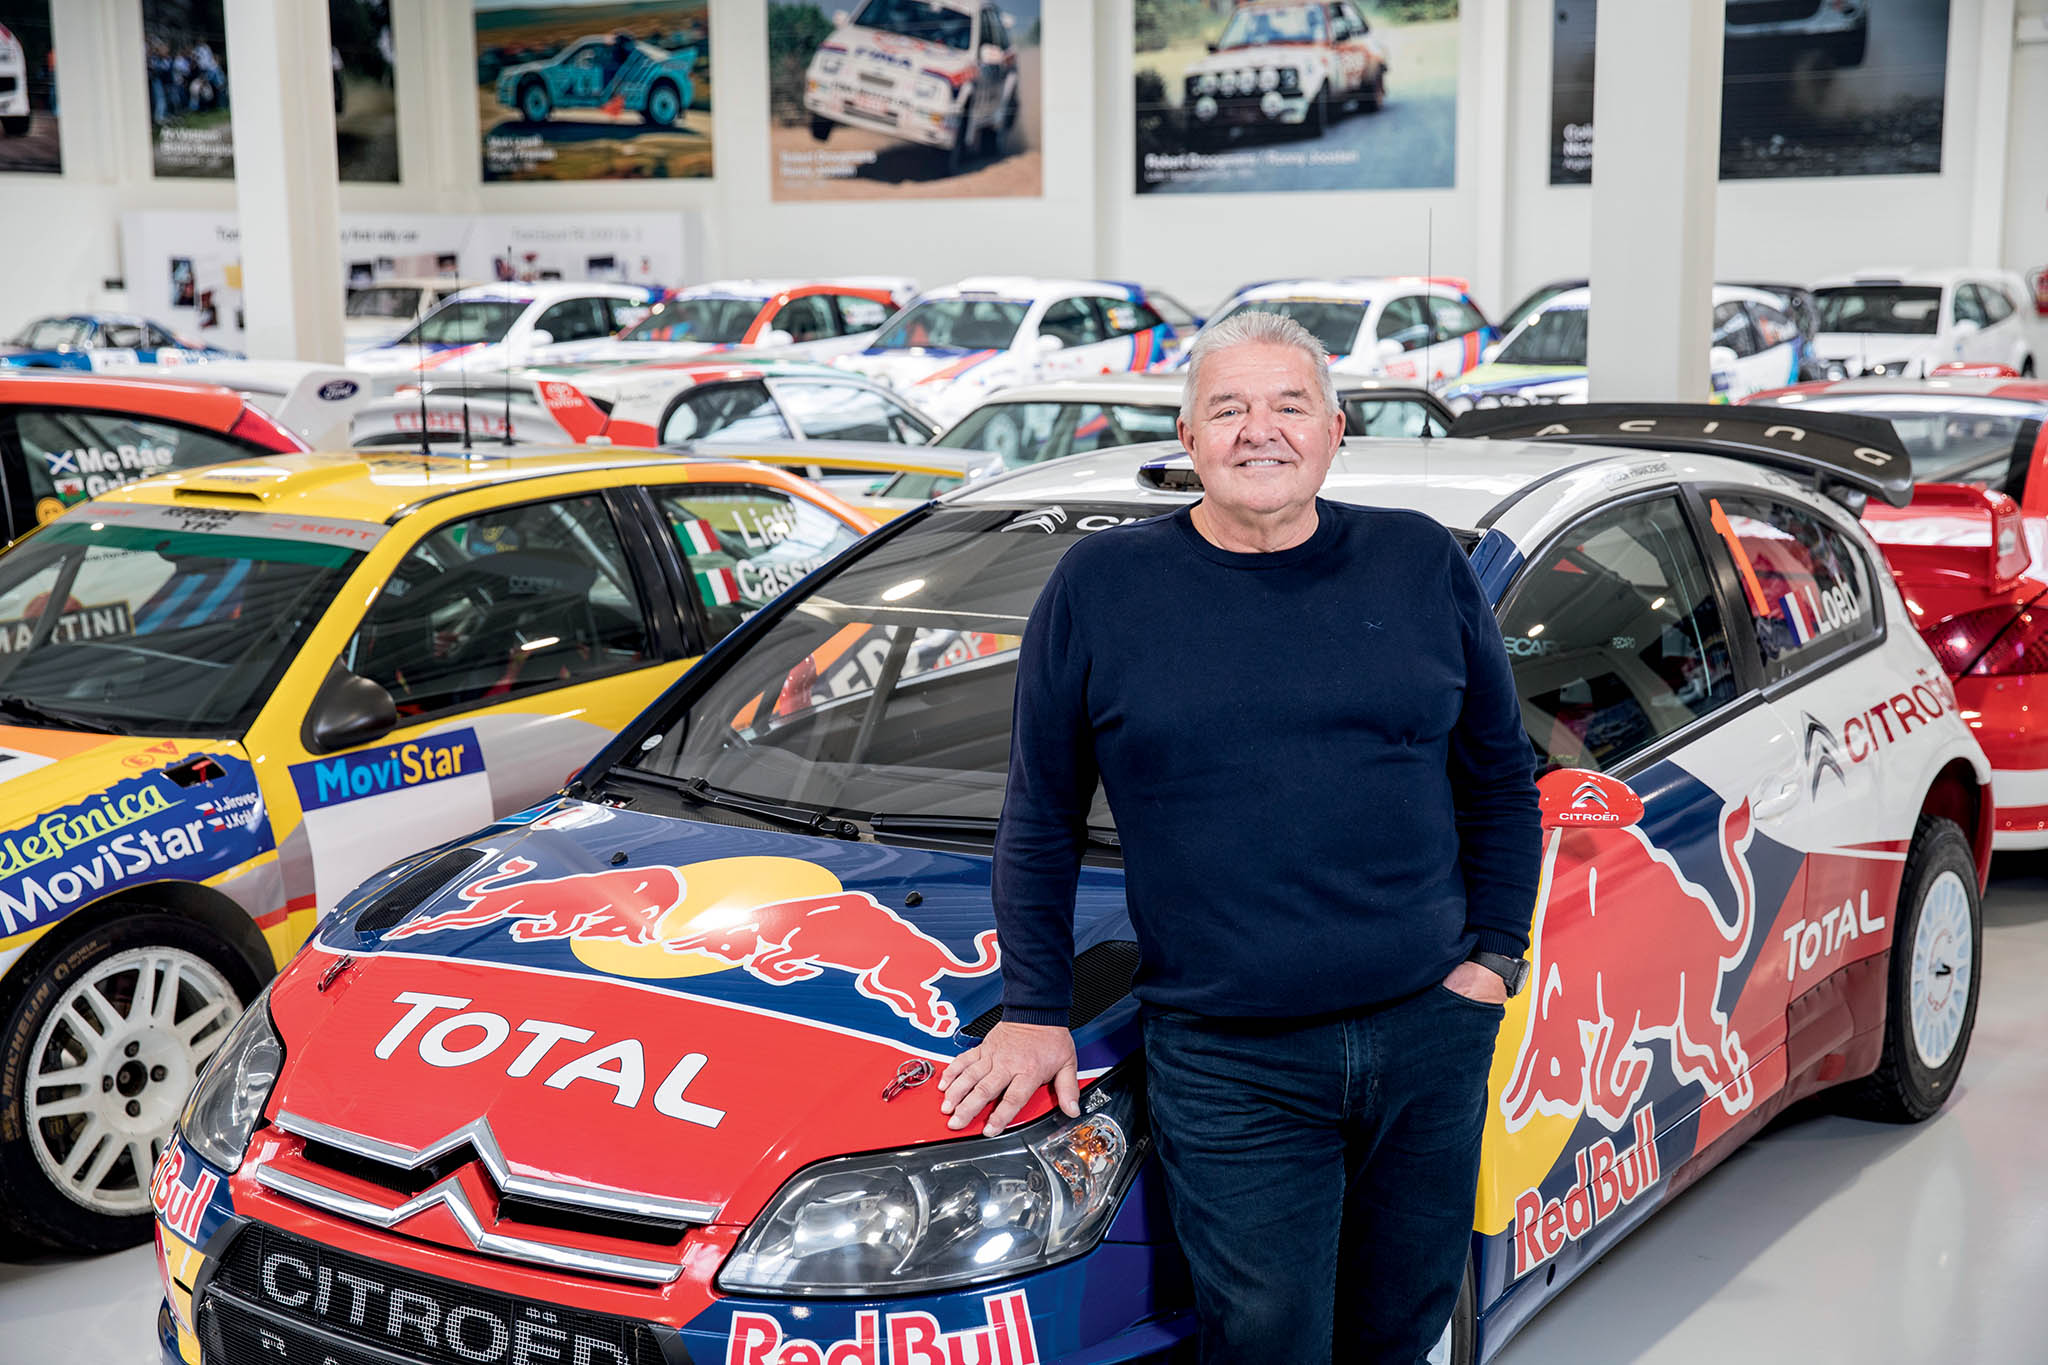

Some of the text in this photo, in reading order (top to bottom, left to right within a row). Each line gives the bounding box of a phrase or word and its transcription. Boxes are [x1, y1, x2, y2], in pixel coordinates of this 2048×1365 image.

[75, 444, 173, 473] McRae
[1474, 419, 1893, 467] ACING
[299, 523, 377, 541] SEAT
[1710, 498, 1770, 616] 1
[1804, 570, 1861, 635] Loeb
[313, 743, 465, 803] MoviStar
[1559, 811, 1620, 822] CITROËN
[0, 818, 205, 936] MoviStar
[1783, 888, 1886, 982] TOTAL
[2, 983, 50, 1097] MICHELIN
[373, 991, 728, 1130] TOTAL
[153, 1143, 221, 1245] Bull
[1513, 1100, 1661, 1281] Red Bull
[725, 1288, 1041, 1365] Red Bull
